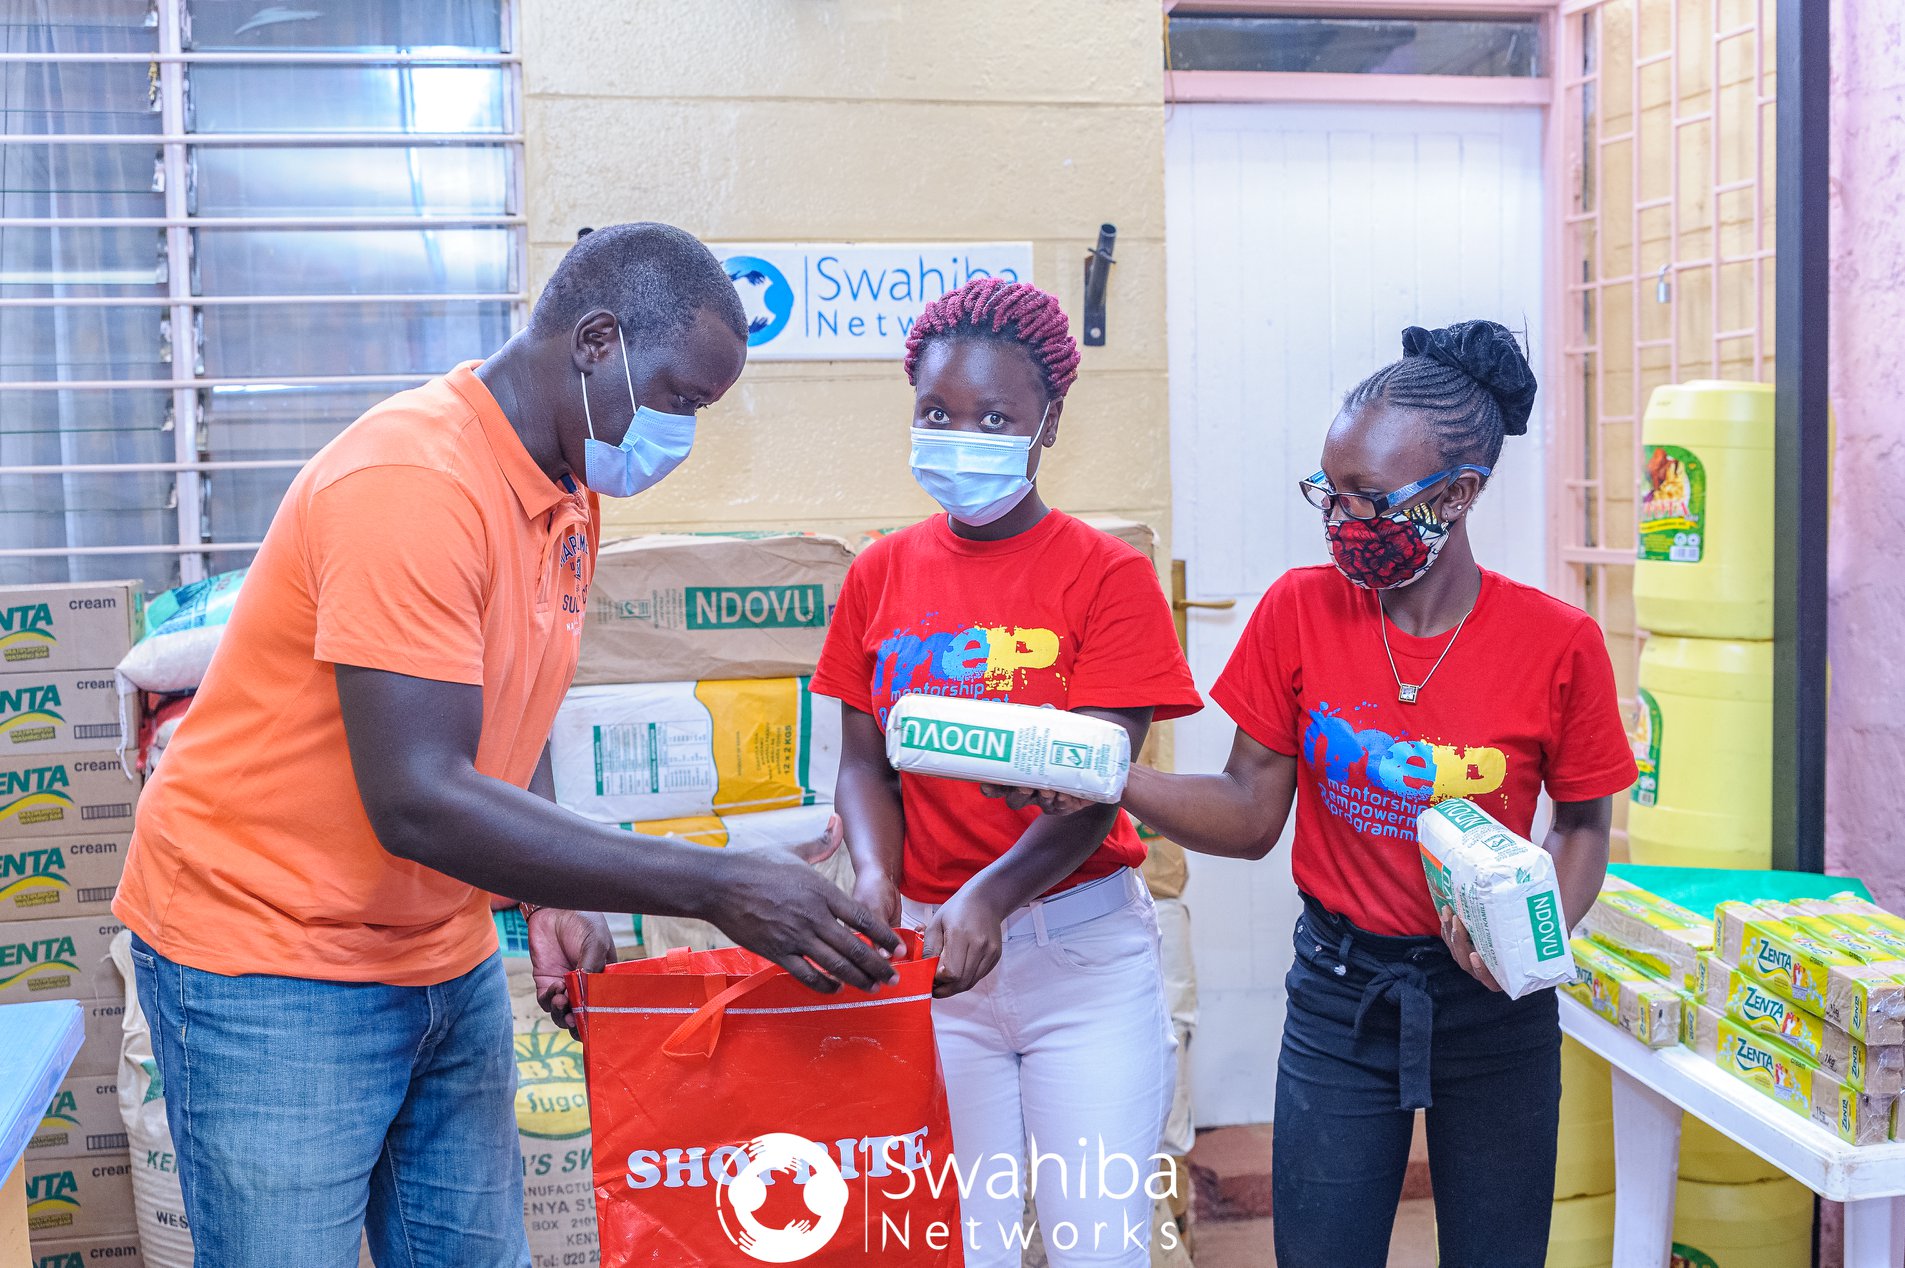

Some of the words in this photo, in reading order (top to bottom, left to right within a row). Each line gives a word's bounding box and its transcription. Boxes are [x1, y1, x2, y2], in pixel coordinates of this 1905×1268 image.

[69, 598, 117, 610] cream
[696, 589, 815, 624] NDOVU
[784, 725, 792, 745] KGS
[901, 720, 1007, 758] NDOVU
[74, 760, 121, 772] cream
[1329, 803, 1419, 842] programm
[0, 847, 66, 878] NTA
[71, 842, 117, 855] cream
[1533, 896, 1558, 956] NDOVU
[0, 936, 76, 967] ENTA
[1759, 939, 1792, 970] ZENTA
[1744, 986, 1784, 1018] ZENTA
[1737, 1037, 1774, 1070] ZENTA
[1824, 1053, 1836, 1069] 1kg
[522, 1153, 552, 1176] 'S
[524, 1182, 591, 1197] NUFACTU
[532, 1220, 559, 1231] BOX
[90, 1244, 137, 1257] cream
[563, 1251, 586, 1266] 020
